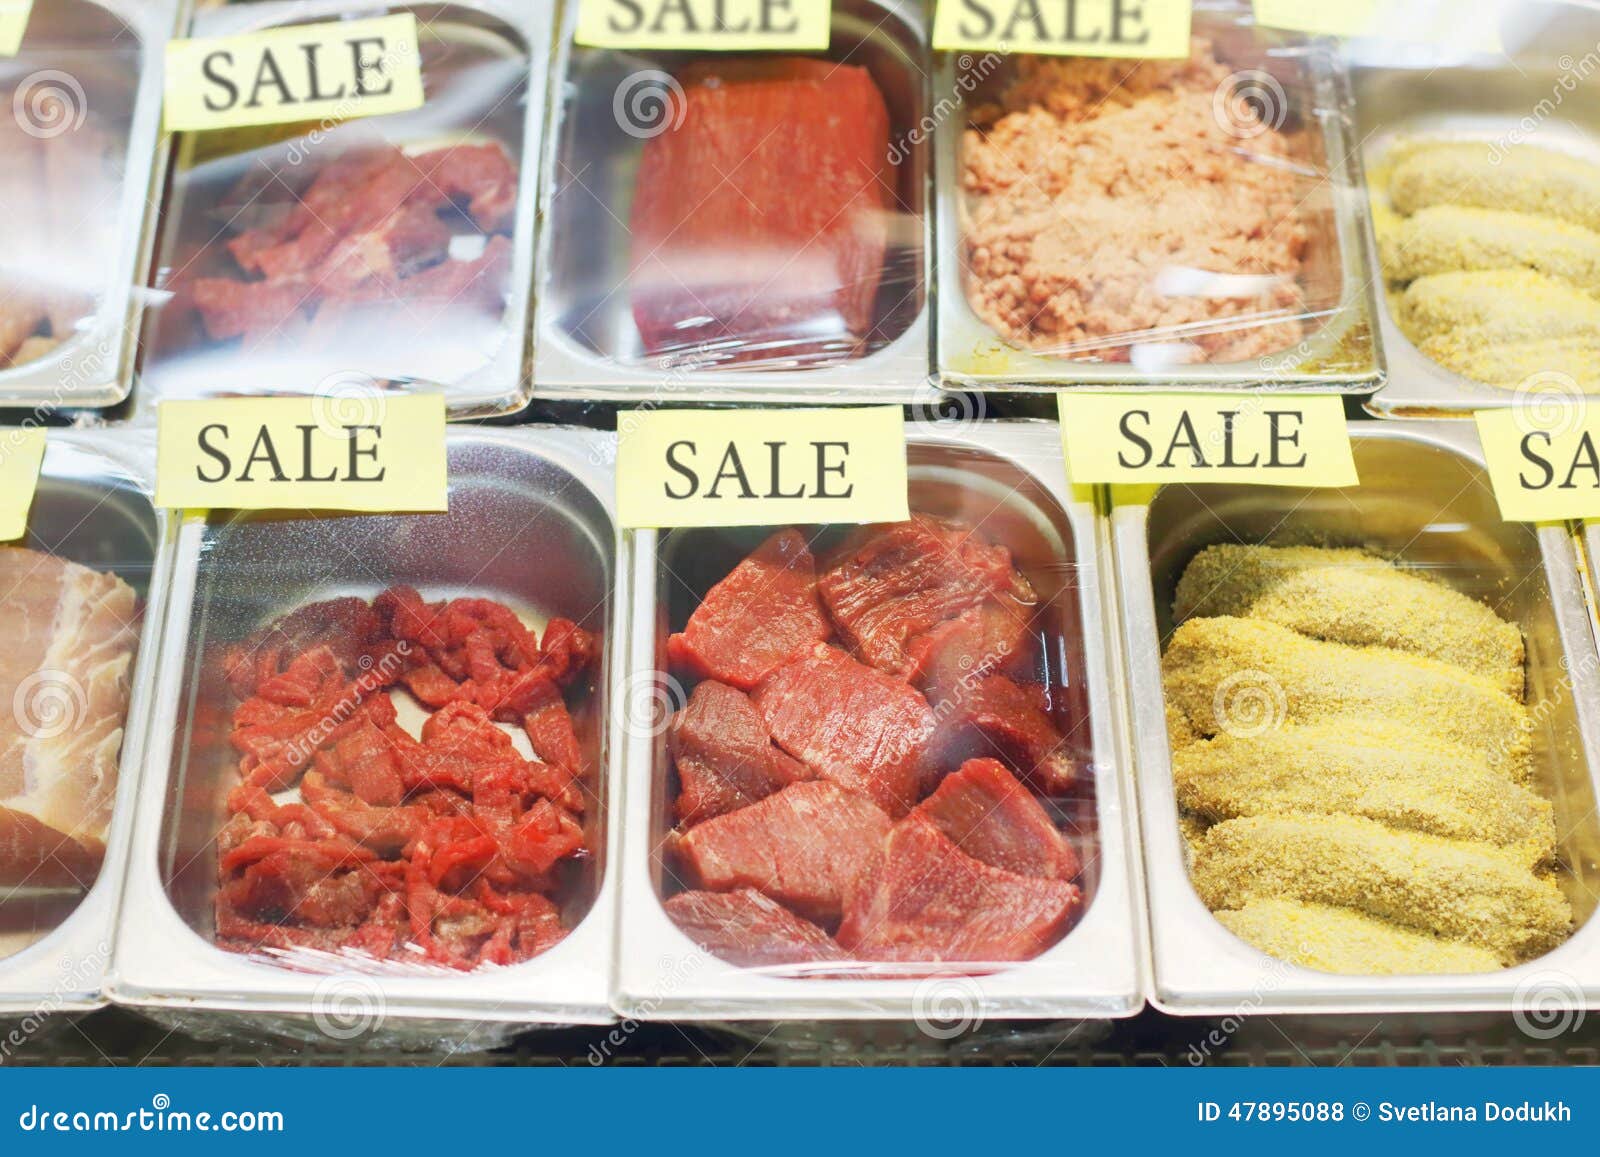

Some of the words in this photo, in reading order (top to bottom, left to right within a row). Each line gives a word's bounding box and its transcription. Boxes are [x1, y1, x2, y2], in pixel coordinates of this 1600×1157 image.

[608, 0, 799, 34] SALE
[958, 0, 1150, 44] SALE
[201, 37, 394, 112] SALE
[195, 424, 387, 483] SALE
[1117, 409, 1307, 469] SALE
[663, 440, 854, 500] SALE
